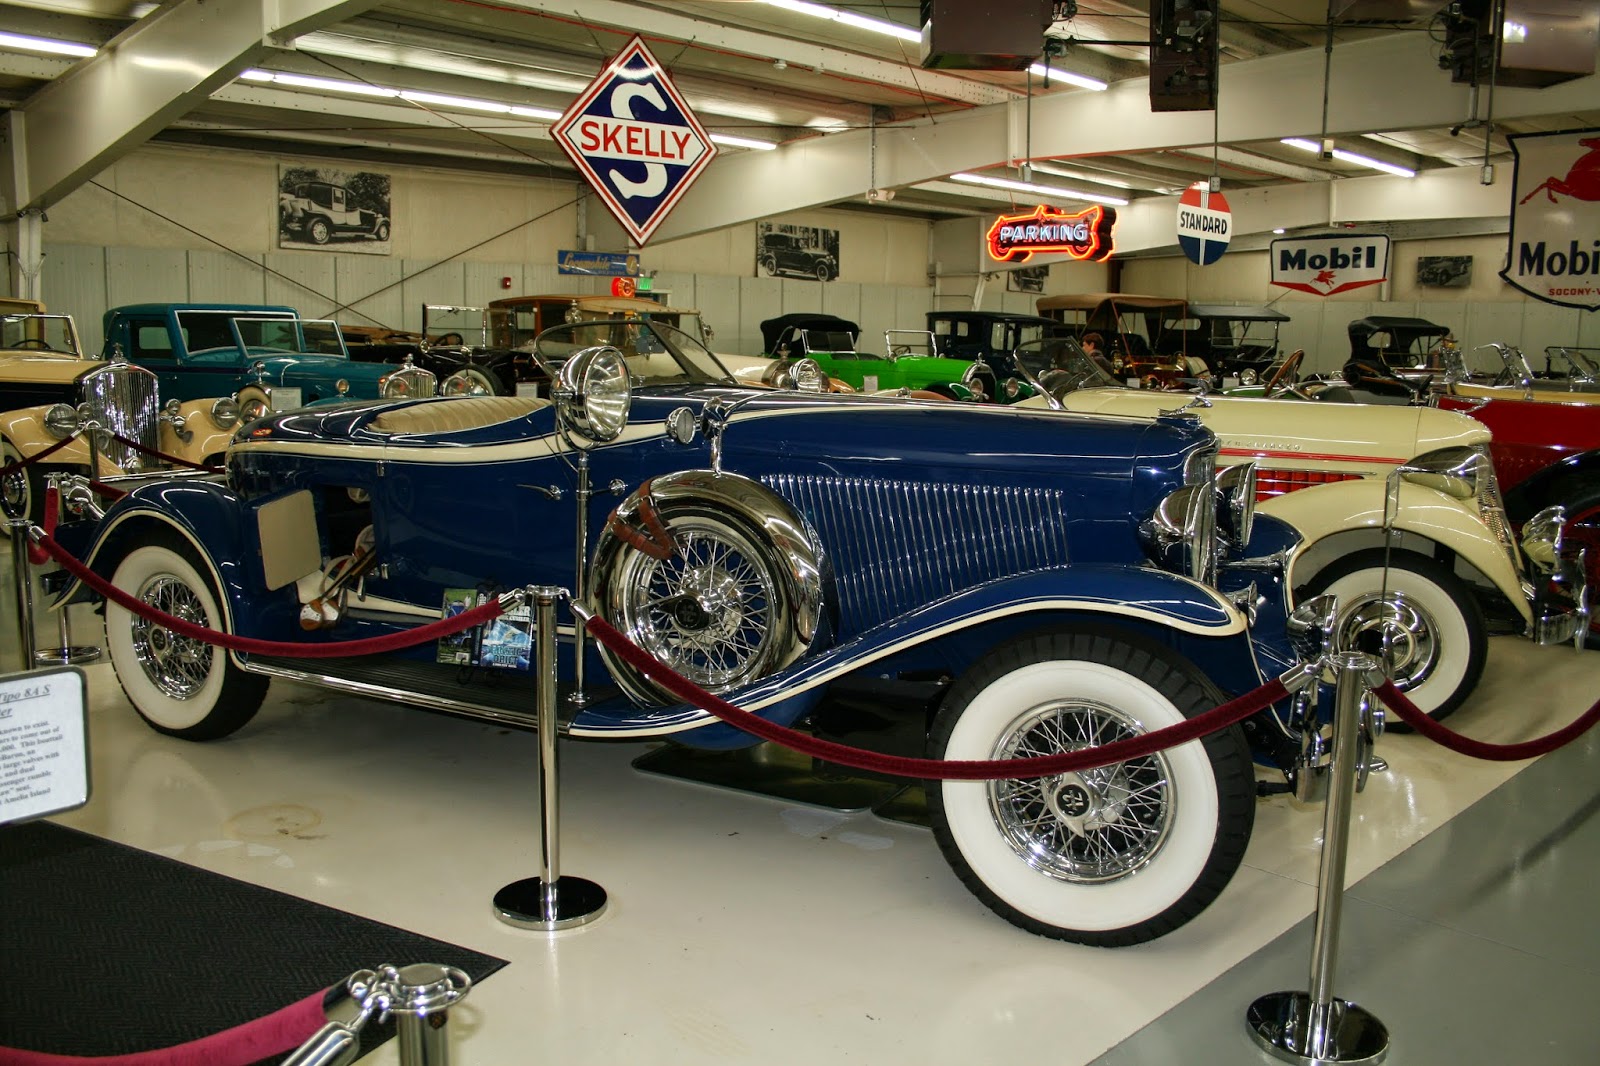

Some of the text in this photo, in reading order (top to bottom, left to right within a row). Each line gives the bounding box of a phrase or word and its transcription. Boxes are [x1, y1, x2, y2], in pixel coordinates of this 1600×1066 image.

[580, 120, 692, 160] SKELLY
[1000, 223, 1089, 243] PARKING
[1180, 210, 1228, 235] STANDARD
[1279, 245, 1376, 271] Mobil
[0, 708, 12, 717] er
